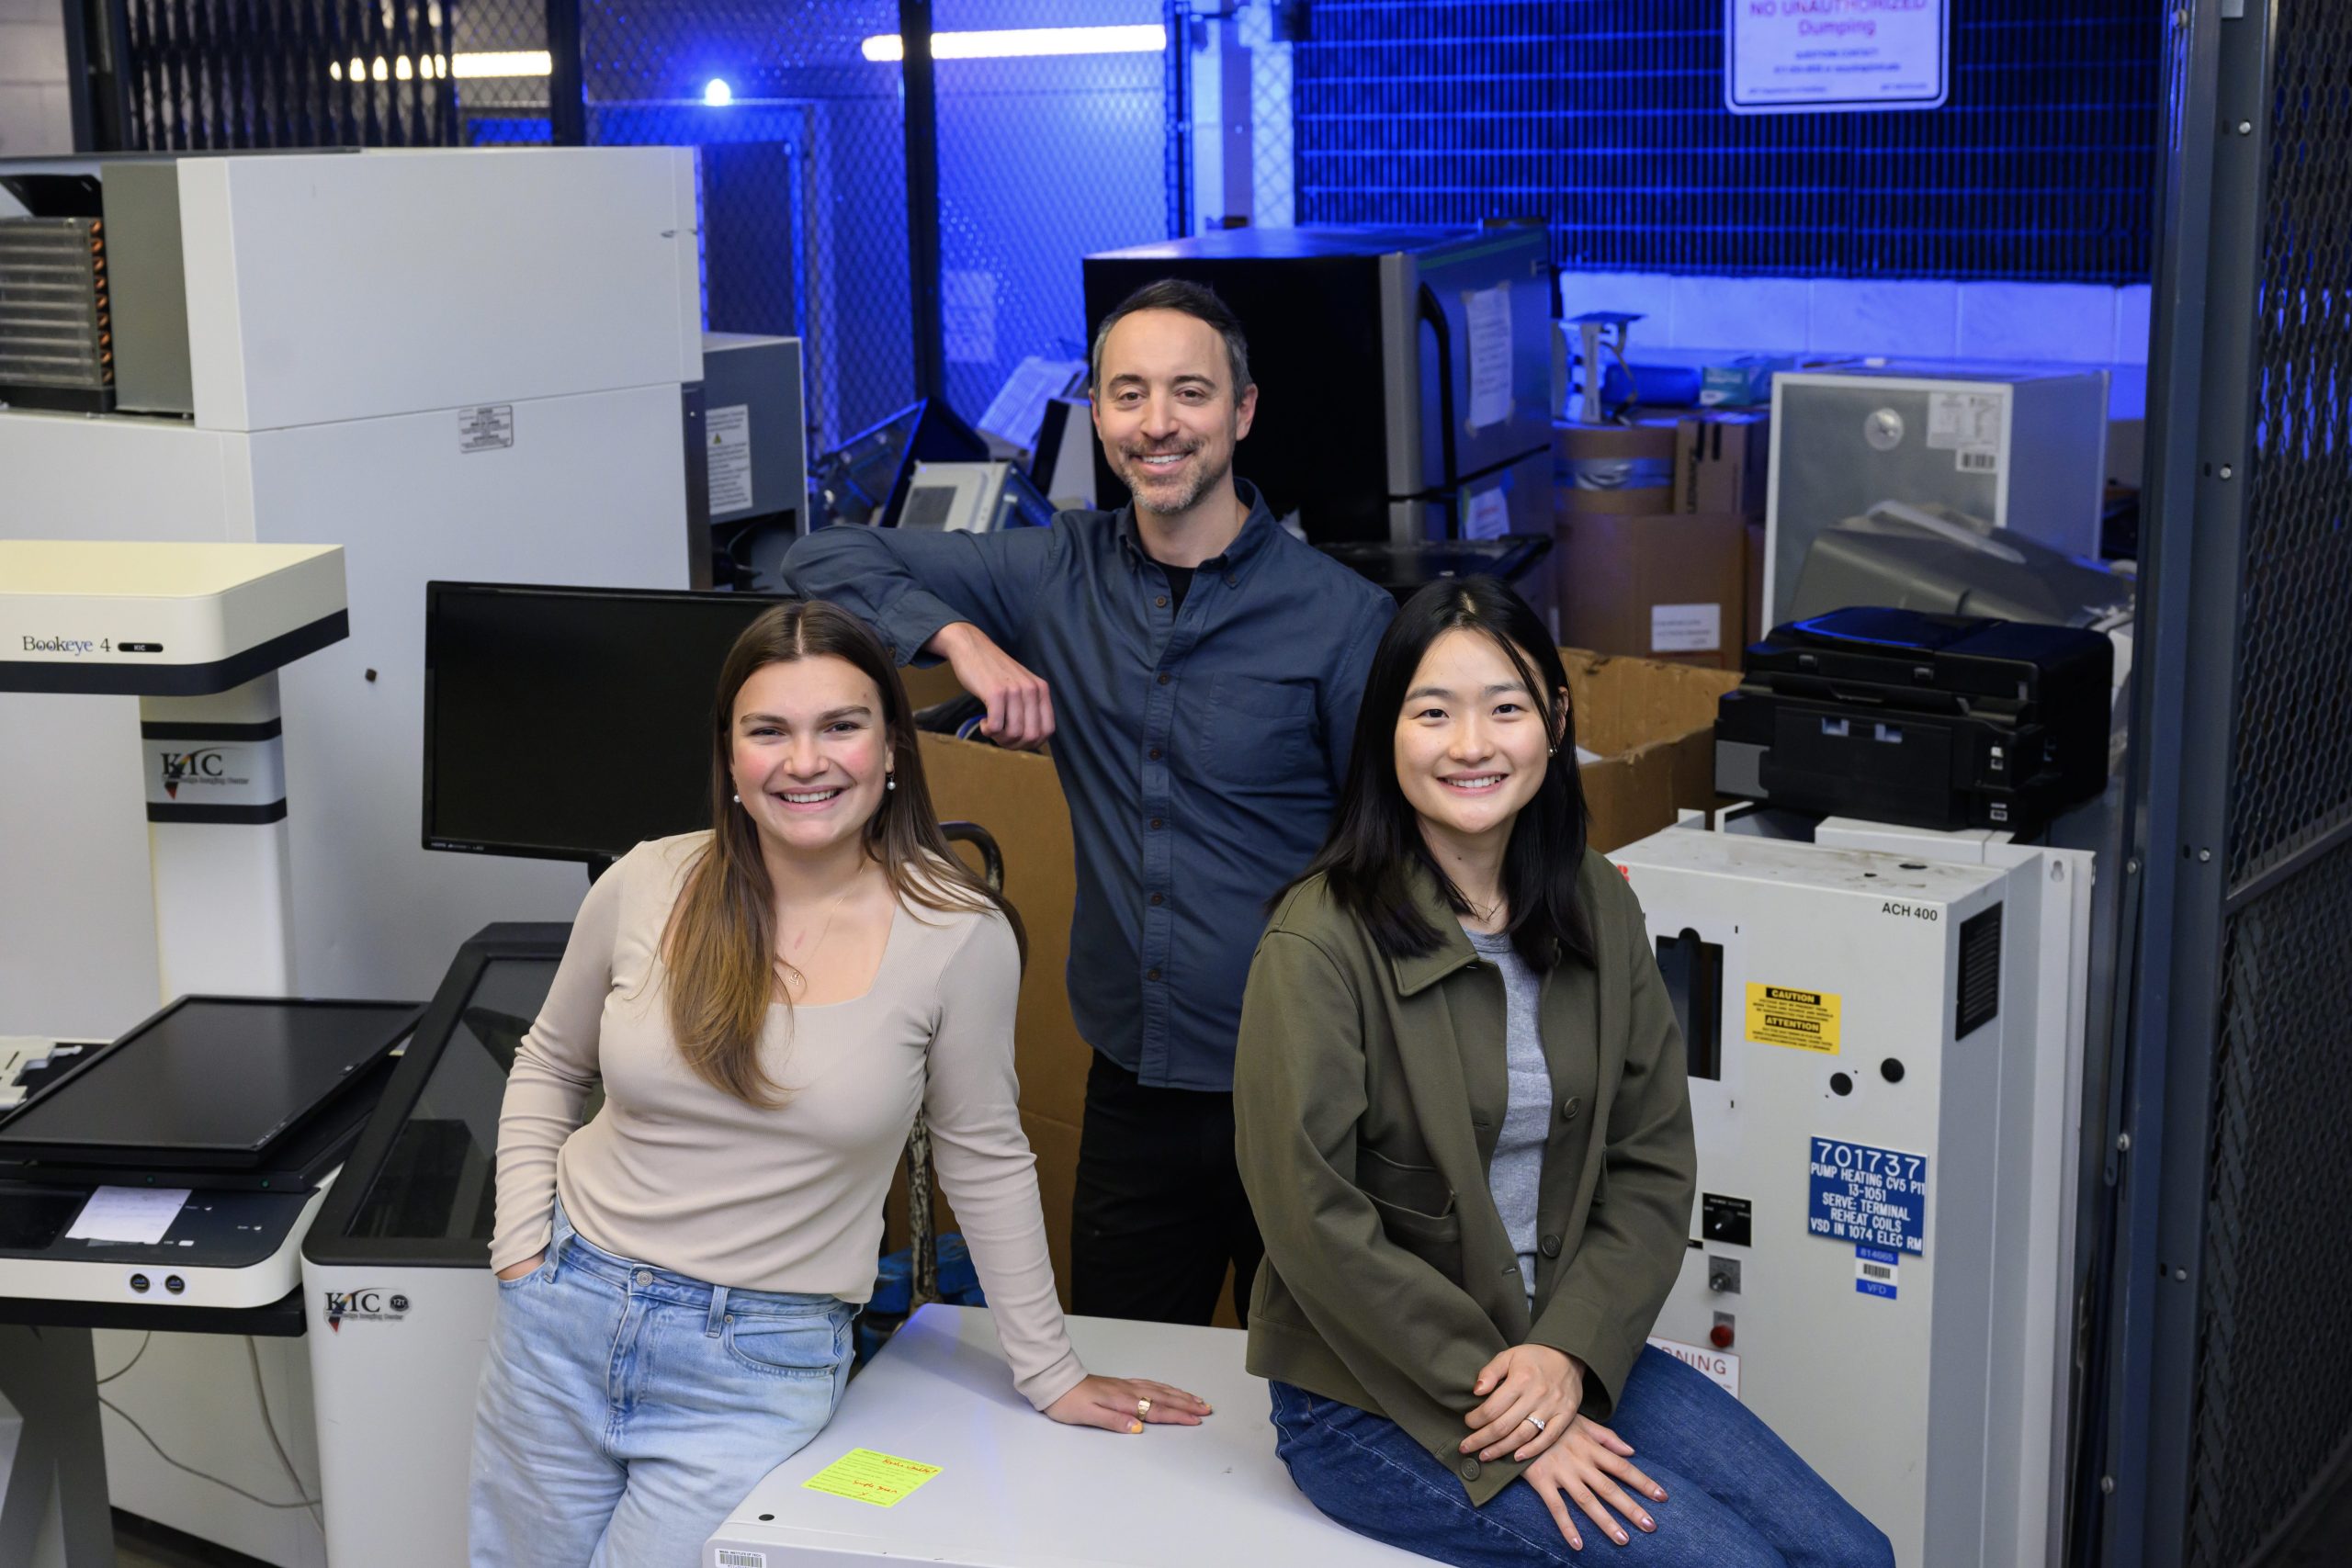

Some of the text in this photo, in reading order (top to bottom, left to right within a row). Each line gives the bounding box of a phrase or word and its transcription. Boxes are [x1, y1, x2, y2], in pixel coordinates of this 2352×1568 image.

[1750, 0, 1776, 16] NO
[1799, 19, 1876, 37] Dumping
[22, 636, 93, 656] Bookeye
[100, 637, 111, 652] 4
[161, 752, 223, 777] KIC
[1882, 902, 1938, 921] ACH 400
[1771, 989, 1815, 1003] CAUTION
[1767, 1017, 1819, 1032] ATTENTION
[1817, 1141, 1921, 1179] 701737
[1811, 1162, 1838, 1179] PUMP
[1841, 1168, 1883, 1188] HEATING
[1886, 1178, 1906, 1192] CV5
[1848, 1183, 1887, 1201] 13-1051
[1823, 1191, 1911, 1221] SERVE: TERMINAL
[1830, 1208, 1902, 1233] REHEAT COILS
[1810, 1217, 1922, 1251] VSD IN 1074 ELEC RM
[1866, 1283, 1887, 1295] VFD
[325, 1292, 380, 1313] KIC
[1661, 1347, 1726, 1375] NING
